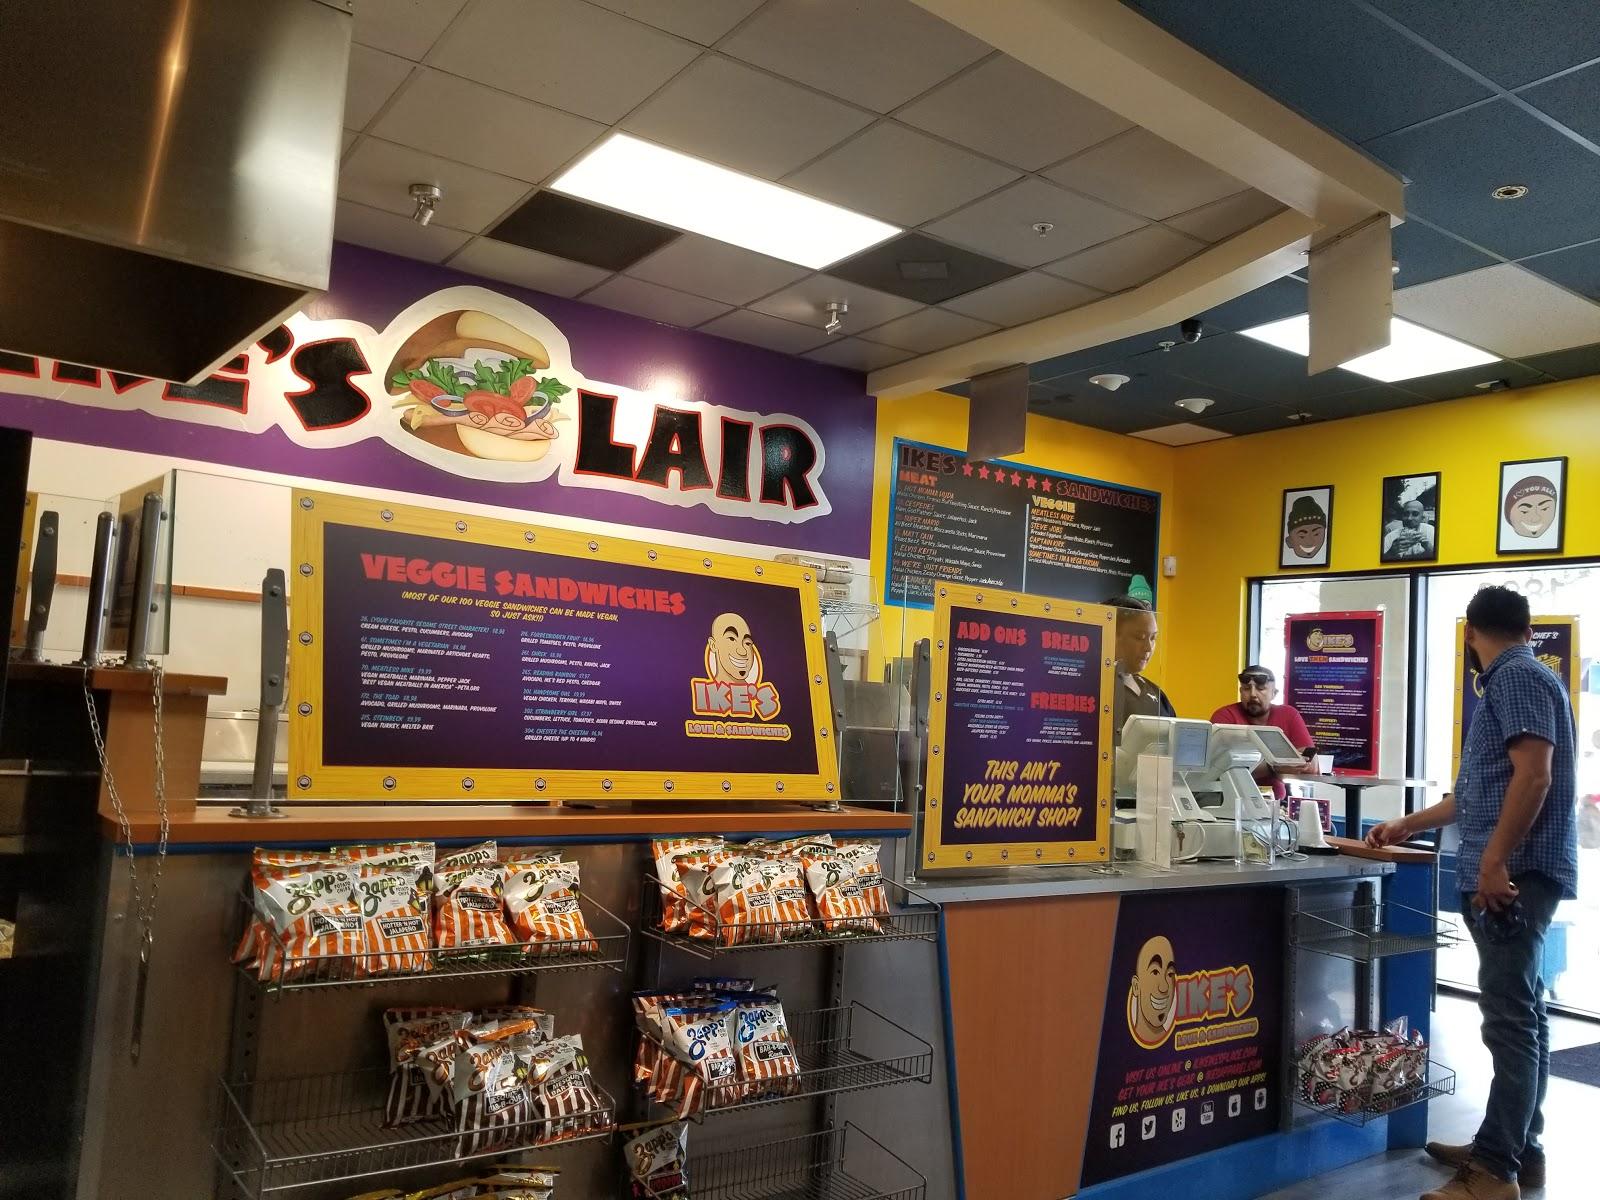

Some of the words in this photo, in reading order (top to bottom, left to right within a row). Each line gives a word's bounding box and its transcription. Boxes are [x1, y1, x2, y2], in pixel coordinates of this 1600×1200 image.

[575, 391, 818, 511] LAIR
[901, 445, 957, 476] IKE'S
[899, 470, 938, 487] MEAT
[1032, 495, 1075, 513] VEGGIE
[1031, 508, 1059, 519] MEATLESS
[1060, 513, 1075, 522] MIKE
[1031, 522, 1048, 531] STEVE
[1049, 525, 1063, 534] JOBS
[900, 544, 917, 553] ELVIS
[1030, 537, 1052, 546] CAPTAIN
[902, 560, 921, 569] WE'RE
[924, 563, 938, 571] JUST
[1029, 550, 1058, 561] SOMETIMES
[360, 553, 487, 593] VEGGIE
[494, 570, 686, 615] SANDWICHES
[401, 591, 427, 602] (MOST
[429, 594, 439, 603] OF
[441, 595, 457, 605] OUR
[459, 597, 473, 607] 100
[475, 598, 501, 610] VEGGIE
[503, 601, 548, 615] SANDWICHES
[550, 606, 564, 617] CAN
[565, 608, 574, 618] BE
[576, 609, 596, 620] MADE
[490, 610, 500, 620] SO
[502, 611, 520, 621] JUST
[957, 622, 990, 641] ADD
[994, 626, 1026, 646] ONS
[1041, 631, 1089, 653] BREAD
[693, 681, 778, 718] IKE'S
[1031, 692, 1096, 713] FREEBIES
[688, 723, 715, 734] LOVE
[726, 725, 789, 737] SANDWICHES
[985, 760, 1019, 781] THIS
[1020, 760, 1061, 781] AIN'T
[963, 783, 1005, 804] YOUR
[1007, 782, 1078, 804] MOMMA'S
[954, 807, 1036, 829] SANDWICH
[1037, 807, 1082, 827] SHOP!
[1176, 968, 1250, 1021] IKE'S
[1184, 1060, 1192, 1071] @
[1112, 1104, 1127, 1118] FIND
[1129, 1102, 1139, 1114] US,
[1141, 1096, 1164, 1111] FOLLOW
[1165, 1094, 1174, 1106] US,
[1176, 1091, 1189, 1103] LIKE
[1190, 1088, 1199, 1100] US,
[1207, 1080, 1237, 1096] DOWNLOAD
[1238, 1077, 1249, 1089] OUR
[1251, 1073, 1267, 1086] APPS!
[1118, 1087, 1134, 1101] GET
[1136, 1083, 1156, 1098] YOUR
[1197, 1071, 1203, 1082] @
